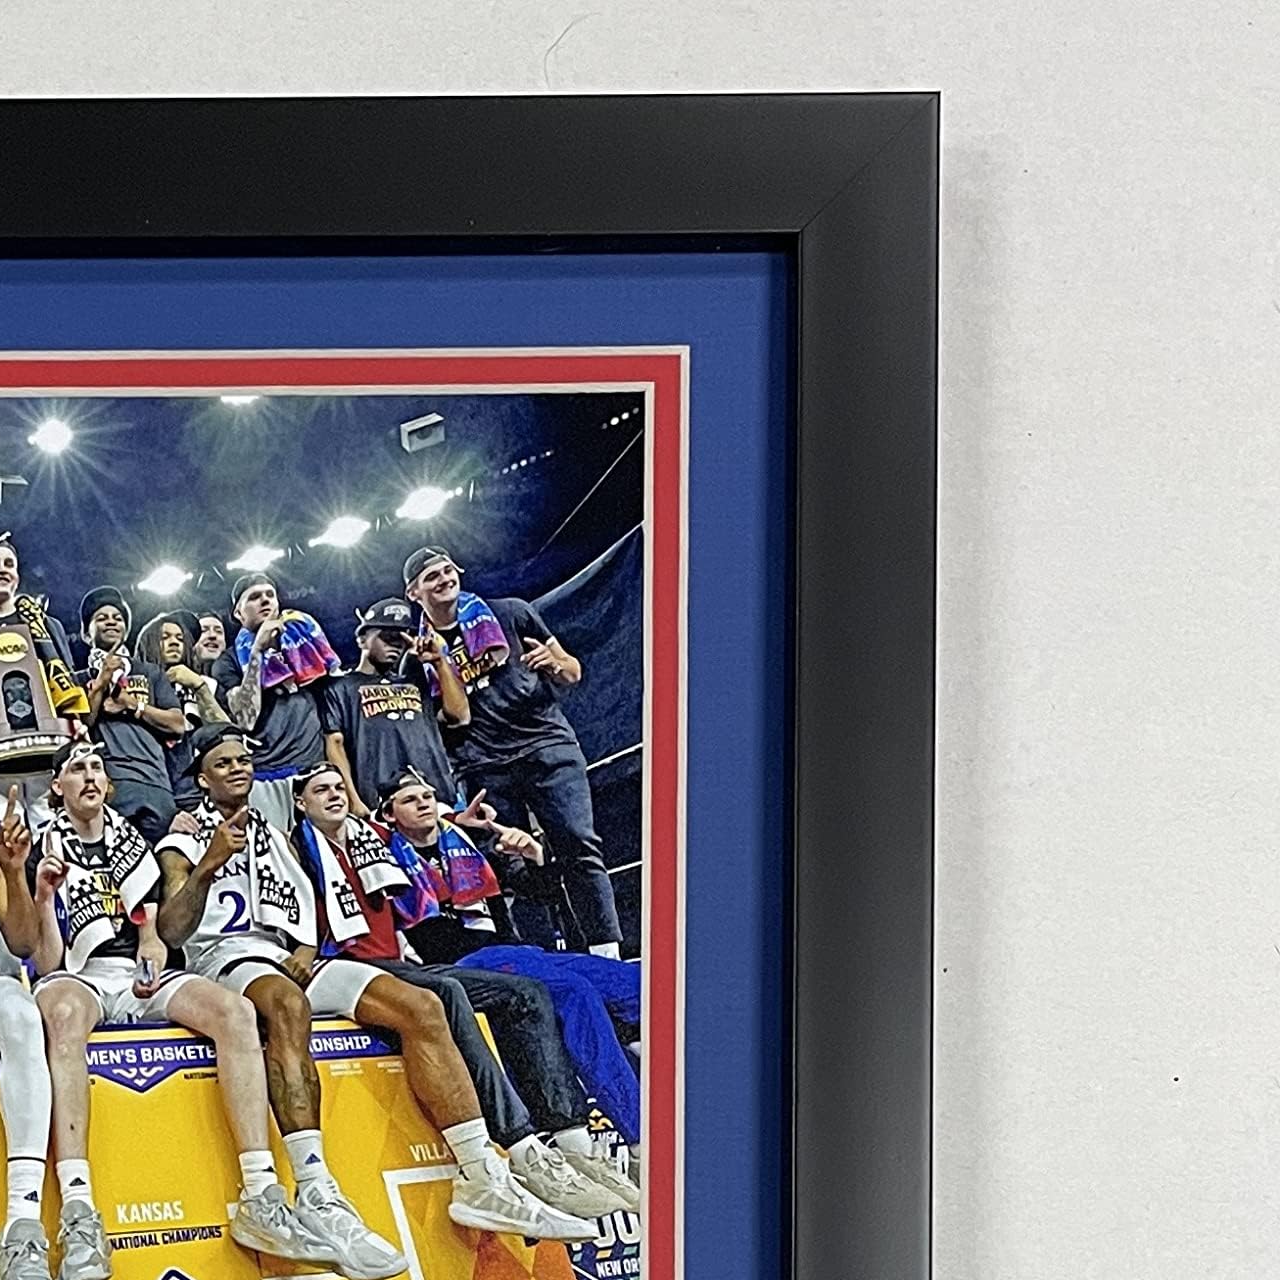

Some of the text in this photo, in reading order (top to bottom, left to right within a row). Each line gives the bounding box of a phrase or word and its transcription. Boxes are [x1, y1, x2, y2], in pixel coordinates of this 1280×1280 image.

[218, 890, 251, 934] 2
[86, 1048, 137, 1066] MEN'S
[410, 1145, 453, 1162] VILLA
[116, 1201, 184, 1225] KANSAS
[110, 1227, 222, 1251] NATIONAL CHAMPIONS
[596, 1259, 621, 1279] NEW
